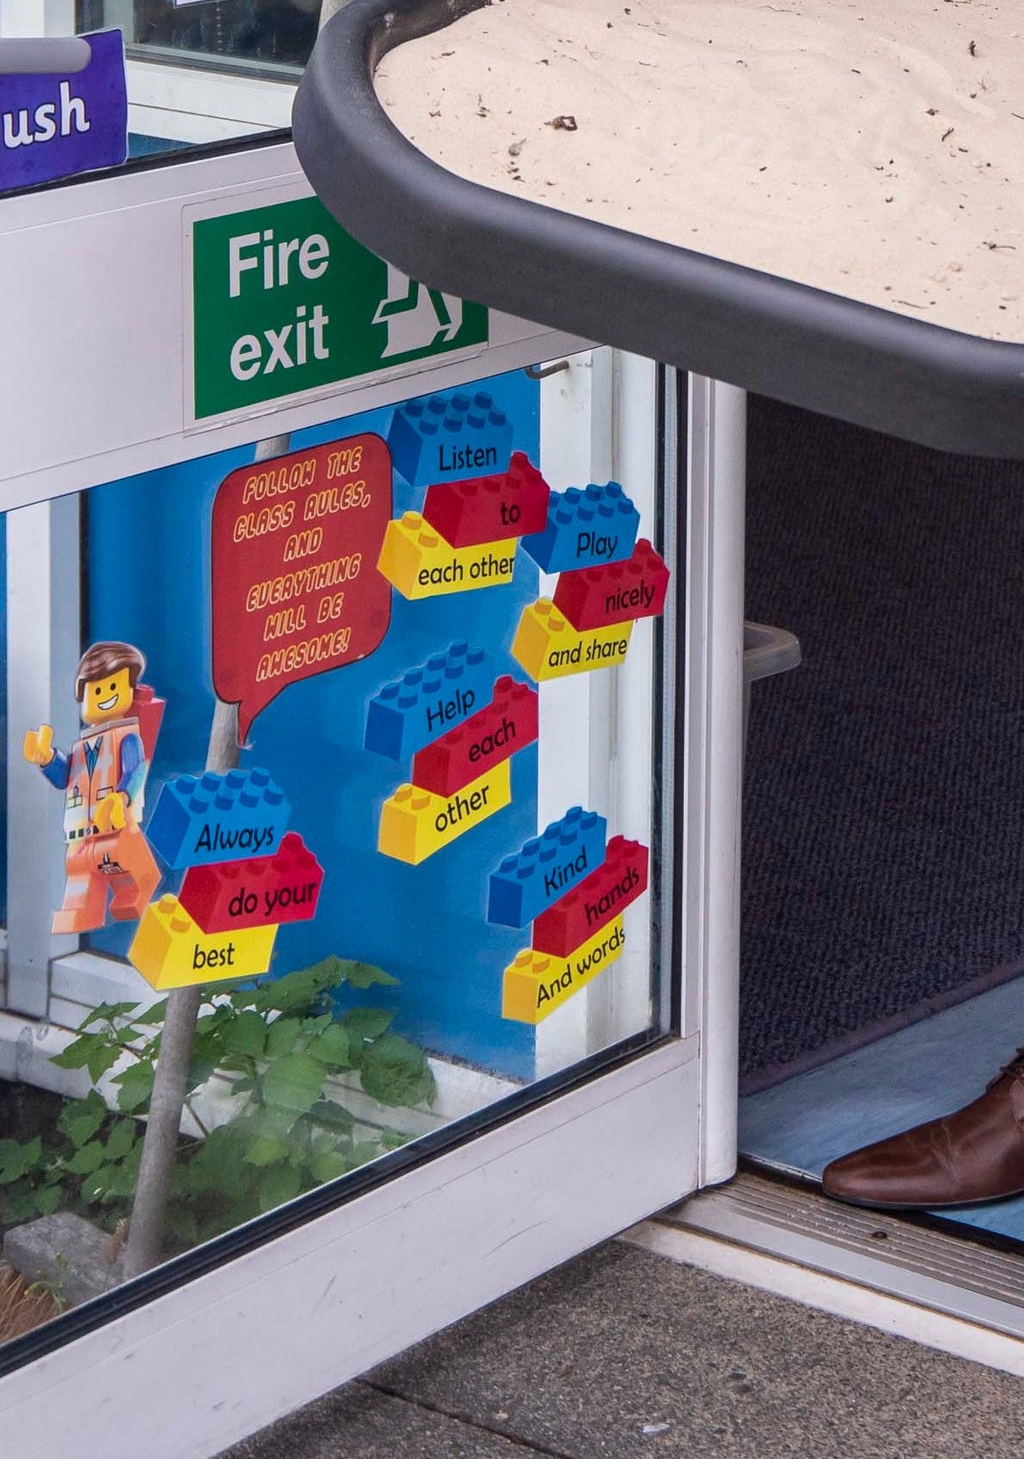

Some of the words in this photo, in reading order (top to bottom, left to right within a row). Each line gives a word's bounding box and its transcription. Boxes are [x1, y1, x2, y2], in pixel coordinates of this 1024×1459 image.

[229, 229, 330, 298] Fire
[230, 305, 330, 381] exit
[242, 459, 316, 505] FOLLOW
[327, 446, 363, 479] THE
[438, 444, 497, 472] Listen
[233, 500, 296, 543] CLASS
[303, 480, 371, 521] RULES,
[500, 501, 521, 526] to
[283, 526, 323, 562] AND
[576, 531, 618, 559] Play
[246, 553, 362, 613] EVERYTHING
[418, 558, 464, 586] each
[469, 554, 515, 579] other
[263, 604, 307, 641] WILL
[317, 592, 344, 624] BE
[605, 579, 655, 614] nicely
[255, 627, 351, 683] AWESOME!
[548, 640, 582, 667] and
[585, 638, 628, 662] share
[425, 688, 475, 732] Help
[468, 720, 516, 763] each
[434, 784, 489, 832] other
[194, 823, 275, 853] Always
[544, 846, 588, 897] Kind
[228, 887, 258, 917] do
[264, 882, 316, 916] your
[584, 867, 640, 927] hands
[193, 942, 235, 969] best
[536, 964, 572, 1009] And
[576, 926, 626, 975] words
